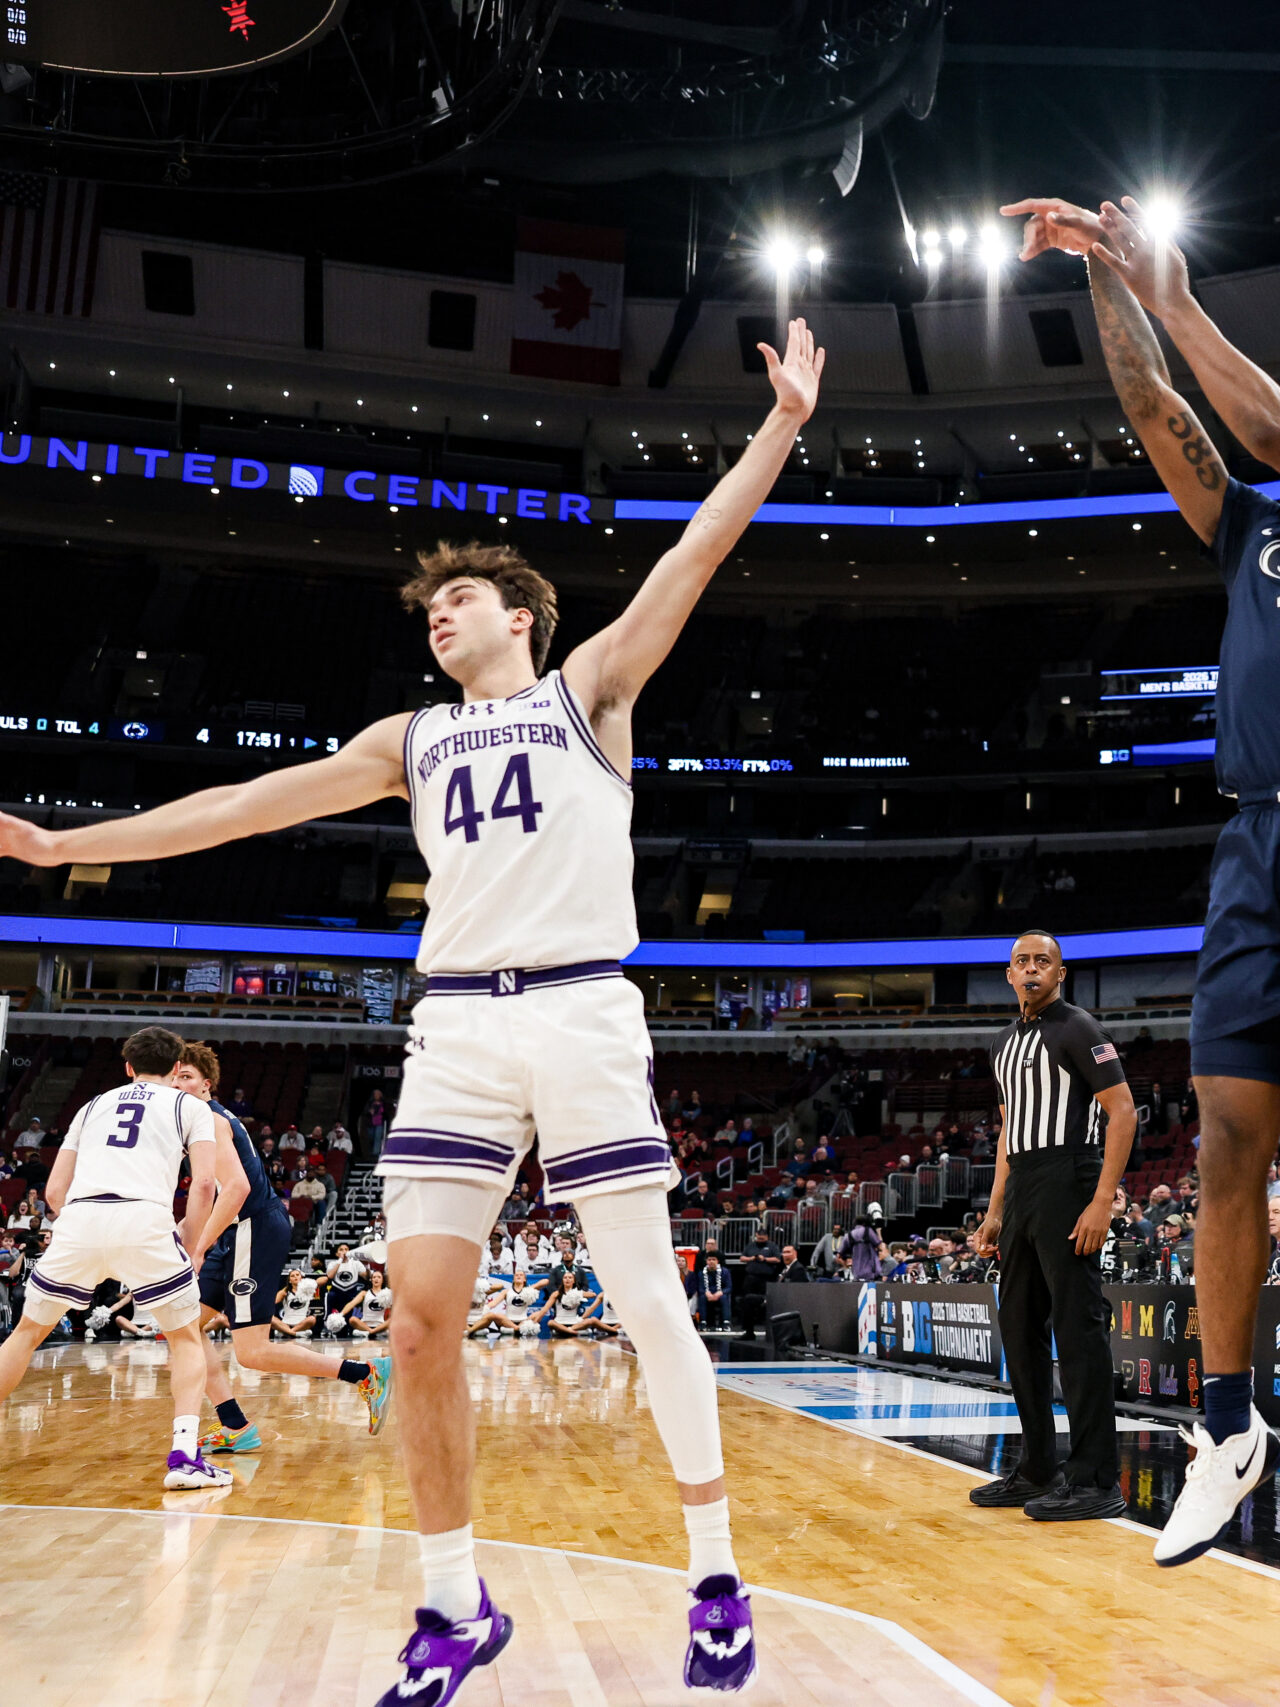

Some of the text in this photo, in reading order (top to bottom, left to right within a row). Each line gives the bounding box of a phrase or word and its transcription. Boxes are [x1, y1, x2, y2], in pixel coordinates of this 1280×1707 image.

[0, 432, 593, 525] UNITED CENTER
[1140, 682, 1171, 693] MEN'S
[55, 720, 82, 734] TOL
[88, 722, 100, 734] 4
[196, 728, 209, 743] 4
[236, 730, 281, 748] 17:51
[326, 737, 339, 752] 3
[416, 723, 569, 786] NORTHWESTERN
[742, 759, 770, 773] FT%
[770, 759, 793, 771] 0%
[823, 757, 847, 767] NICK
[444, 752, 544, 843] 44
[499, 970, 516, 993] N
[11, 1057, 32, 1068] 106
[118, 1090, 156, 1101] WEST
[106, 1102, 145, 1149] 3
[957, 1303, 991, 1324] BASKETBALL
[933, 1325, 992, 1363] TOURNAMENT
[1138, 1358, 1152, 1395] R
